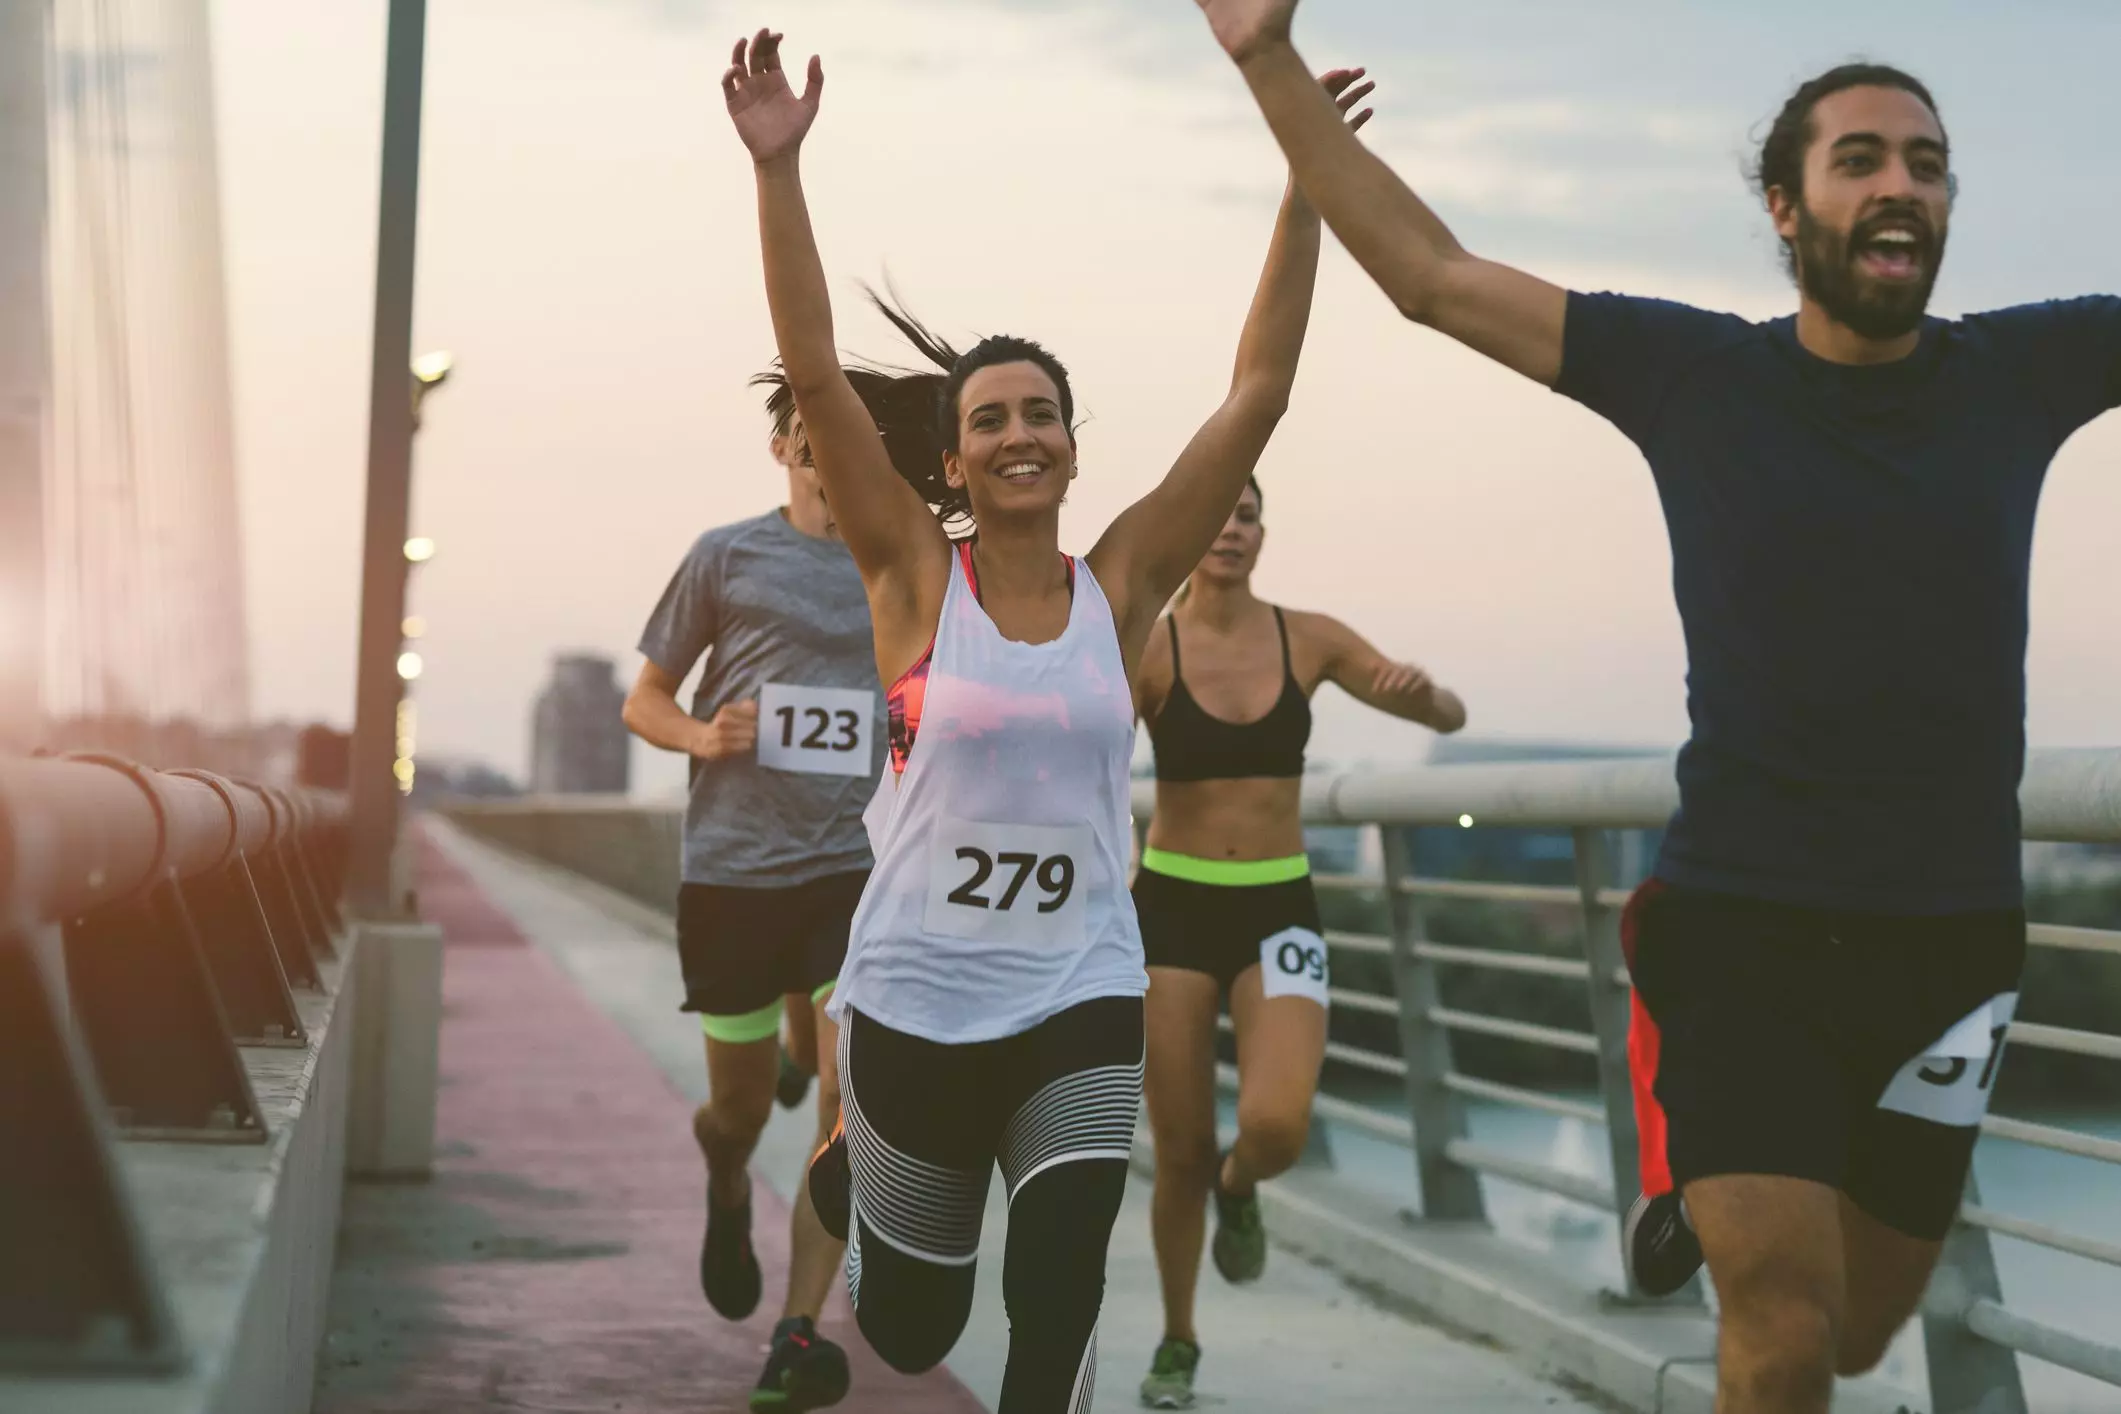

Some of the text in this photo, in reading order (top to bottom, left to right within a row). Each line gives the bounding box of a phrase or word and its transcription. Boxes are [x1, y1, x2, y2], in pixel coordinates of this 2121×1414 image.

[775, 706, 859, 752] 123
[947, 846, 1074, 913] 279
[1277, 942, 1324, 982] 09
